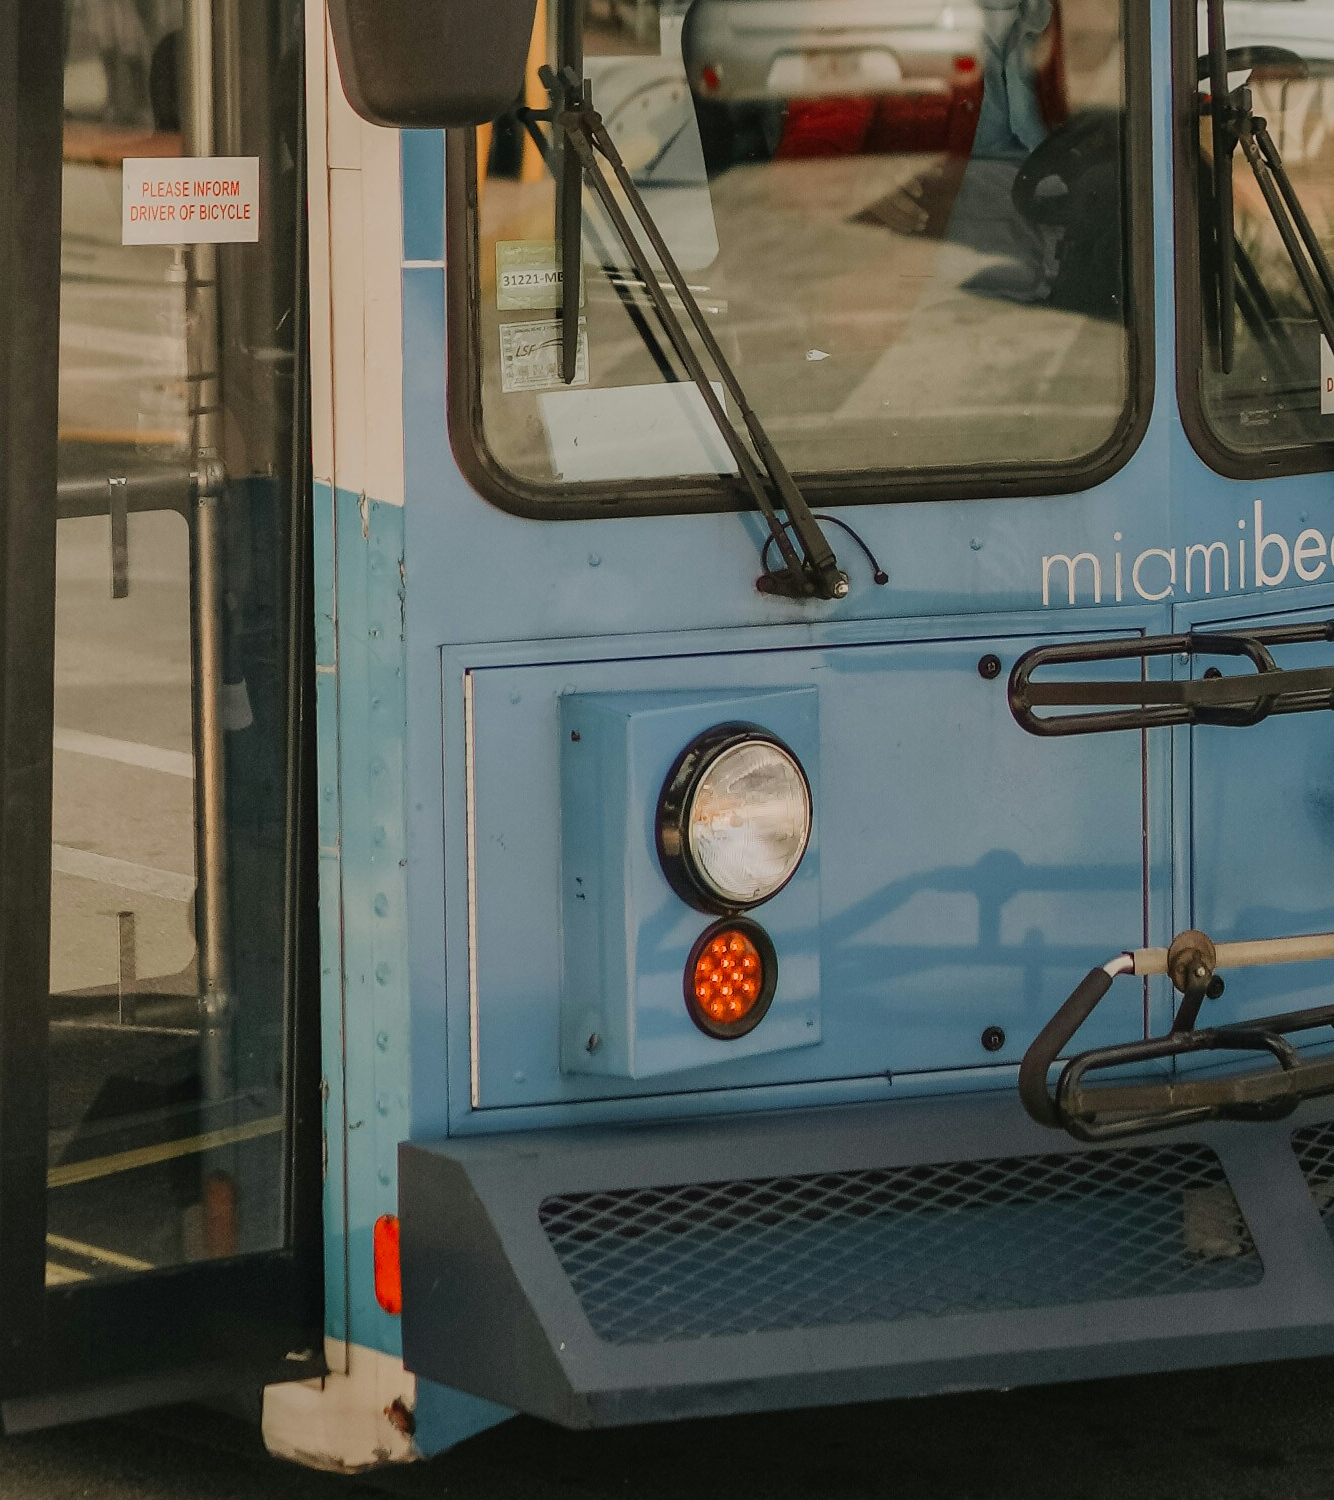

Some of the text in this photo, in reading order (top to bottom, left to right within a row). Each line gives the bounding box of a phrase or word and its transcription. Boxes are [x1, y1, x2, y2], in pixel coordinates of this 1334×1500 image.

[142, 180, 241, 198] PLEASE INFORM
[130, 203, 251, 222] DRIVER OF BICYCLE
